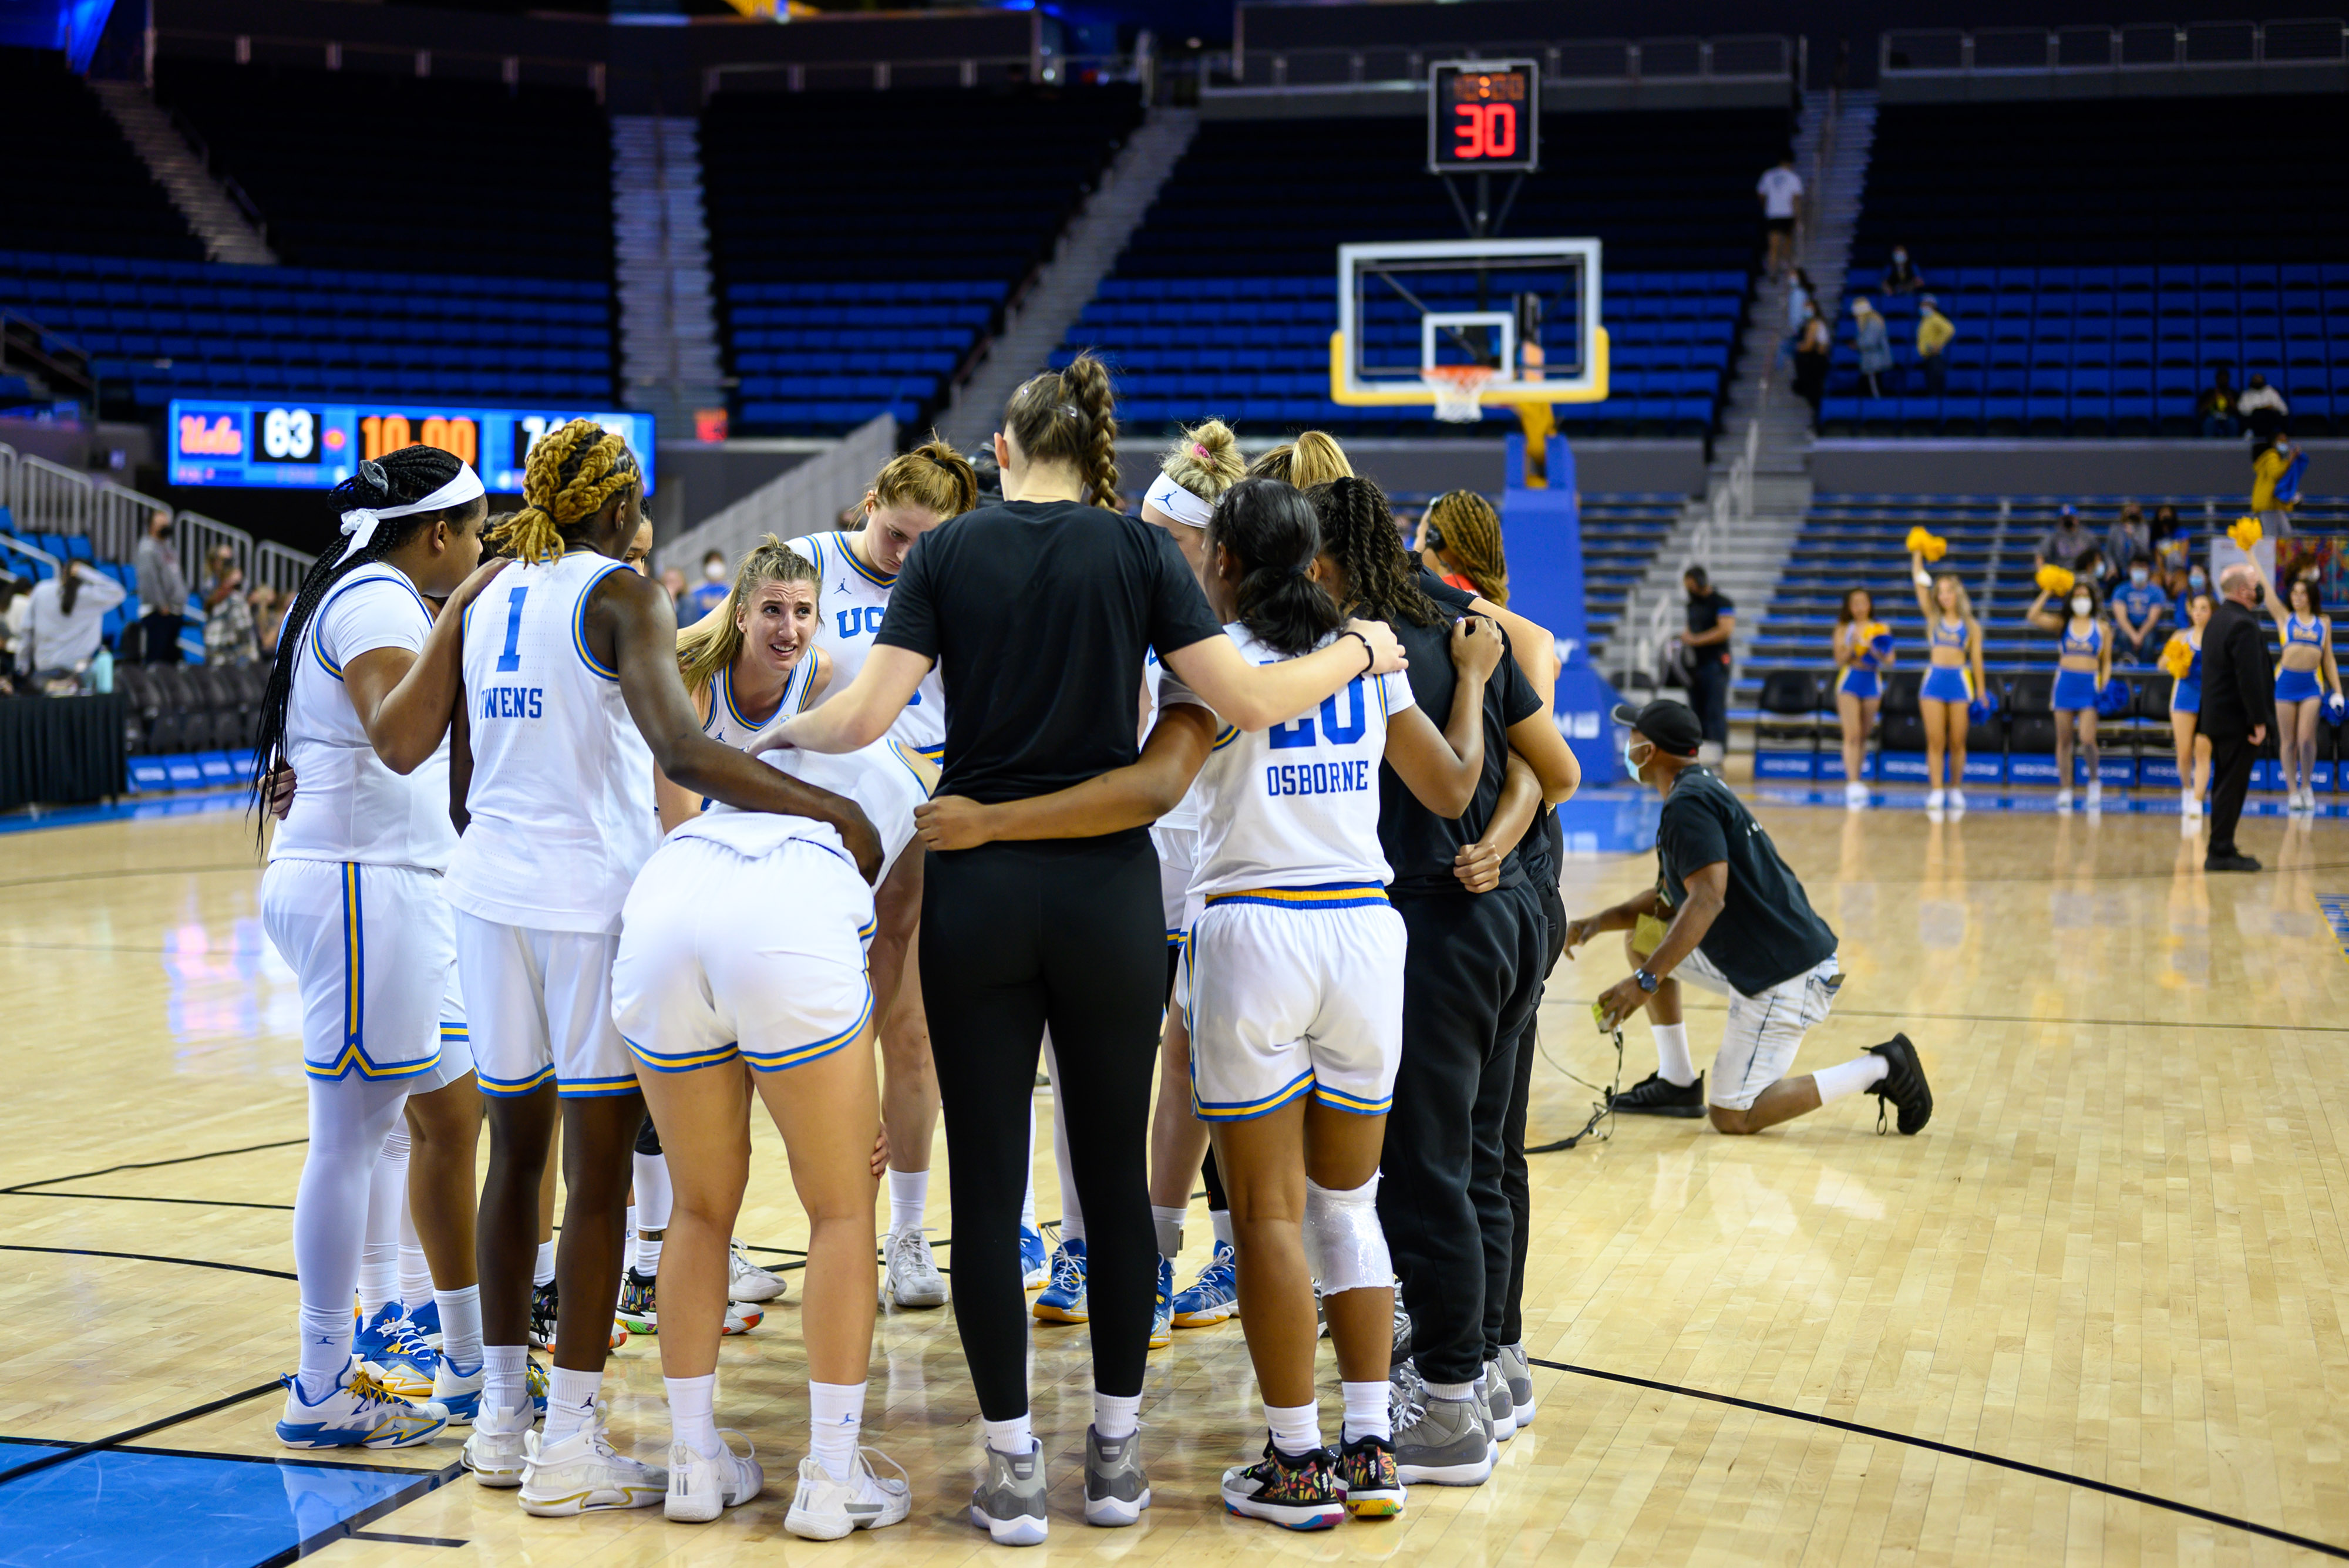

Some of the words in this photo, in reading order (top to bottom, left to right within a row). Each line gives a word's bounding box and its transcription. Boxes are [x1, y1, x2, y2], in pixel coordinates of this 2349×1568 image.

[1454, 103, 1516, 158] 30
[264, 408, 314, 459] 63
[361, 415, 476, 466] 1000
[496, 586, 529, 672] 1
[1267, 761, 1369, 796] OSBORNE
